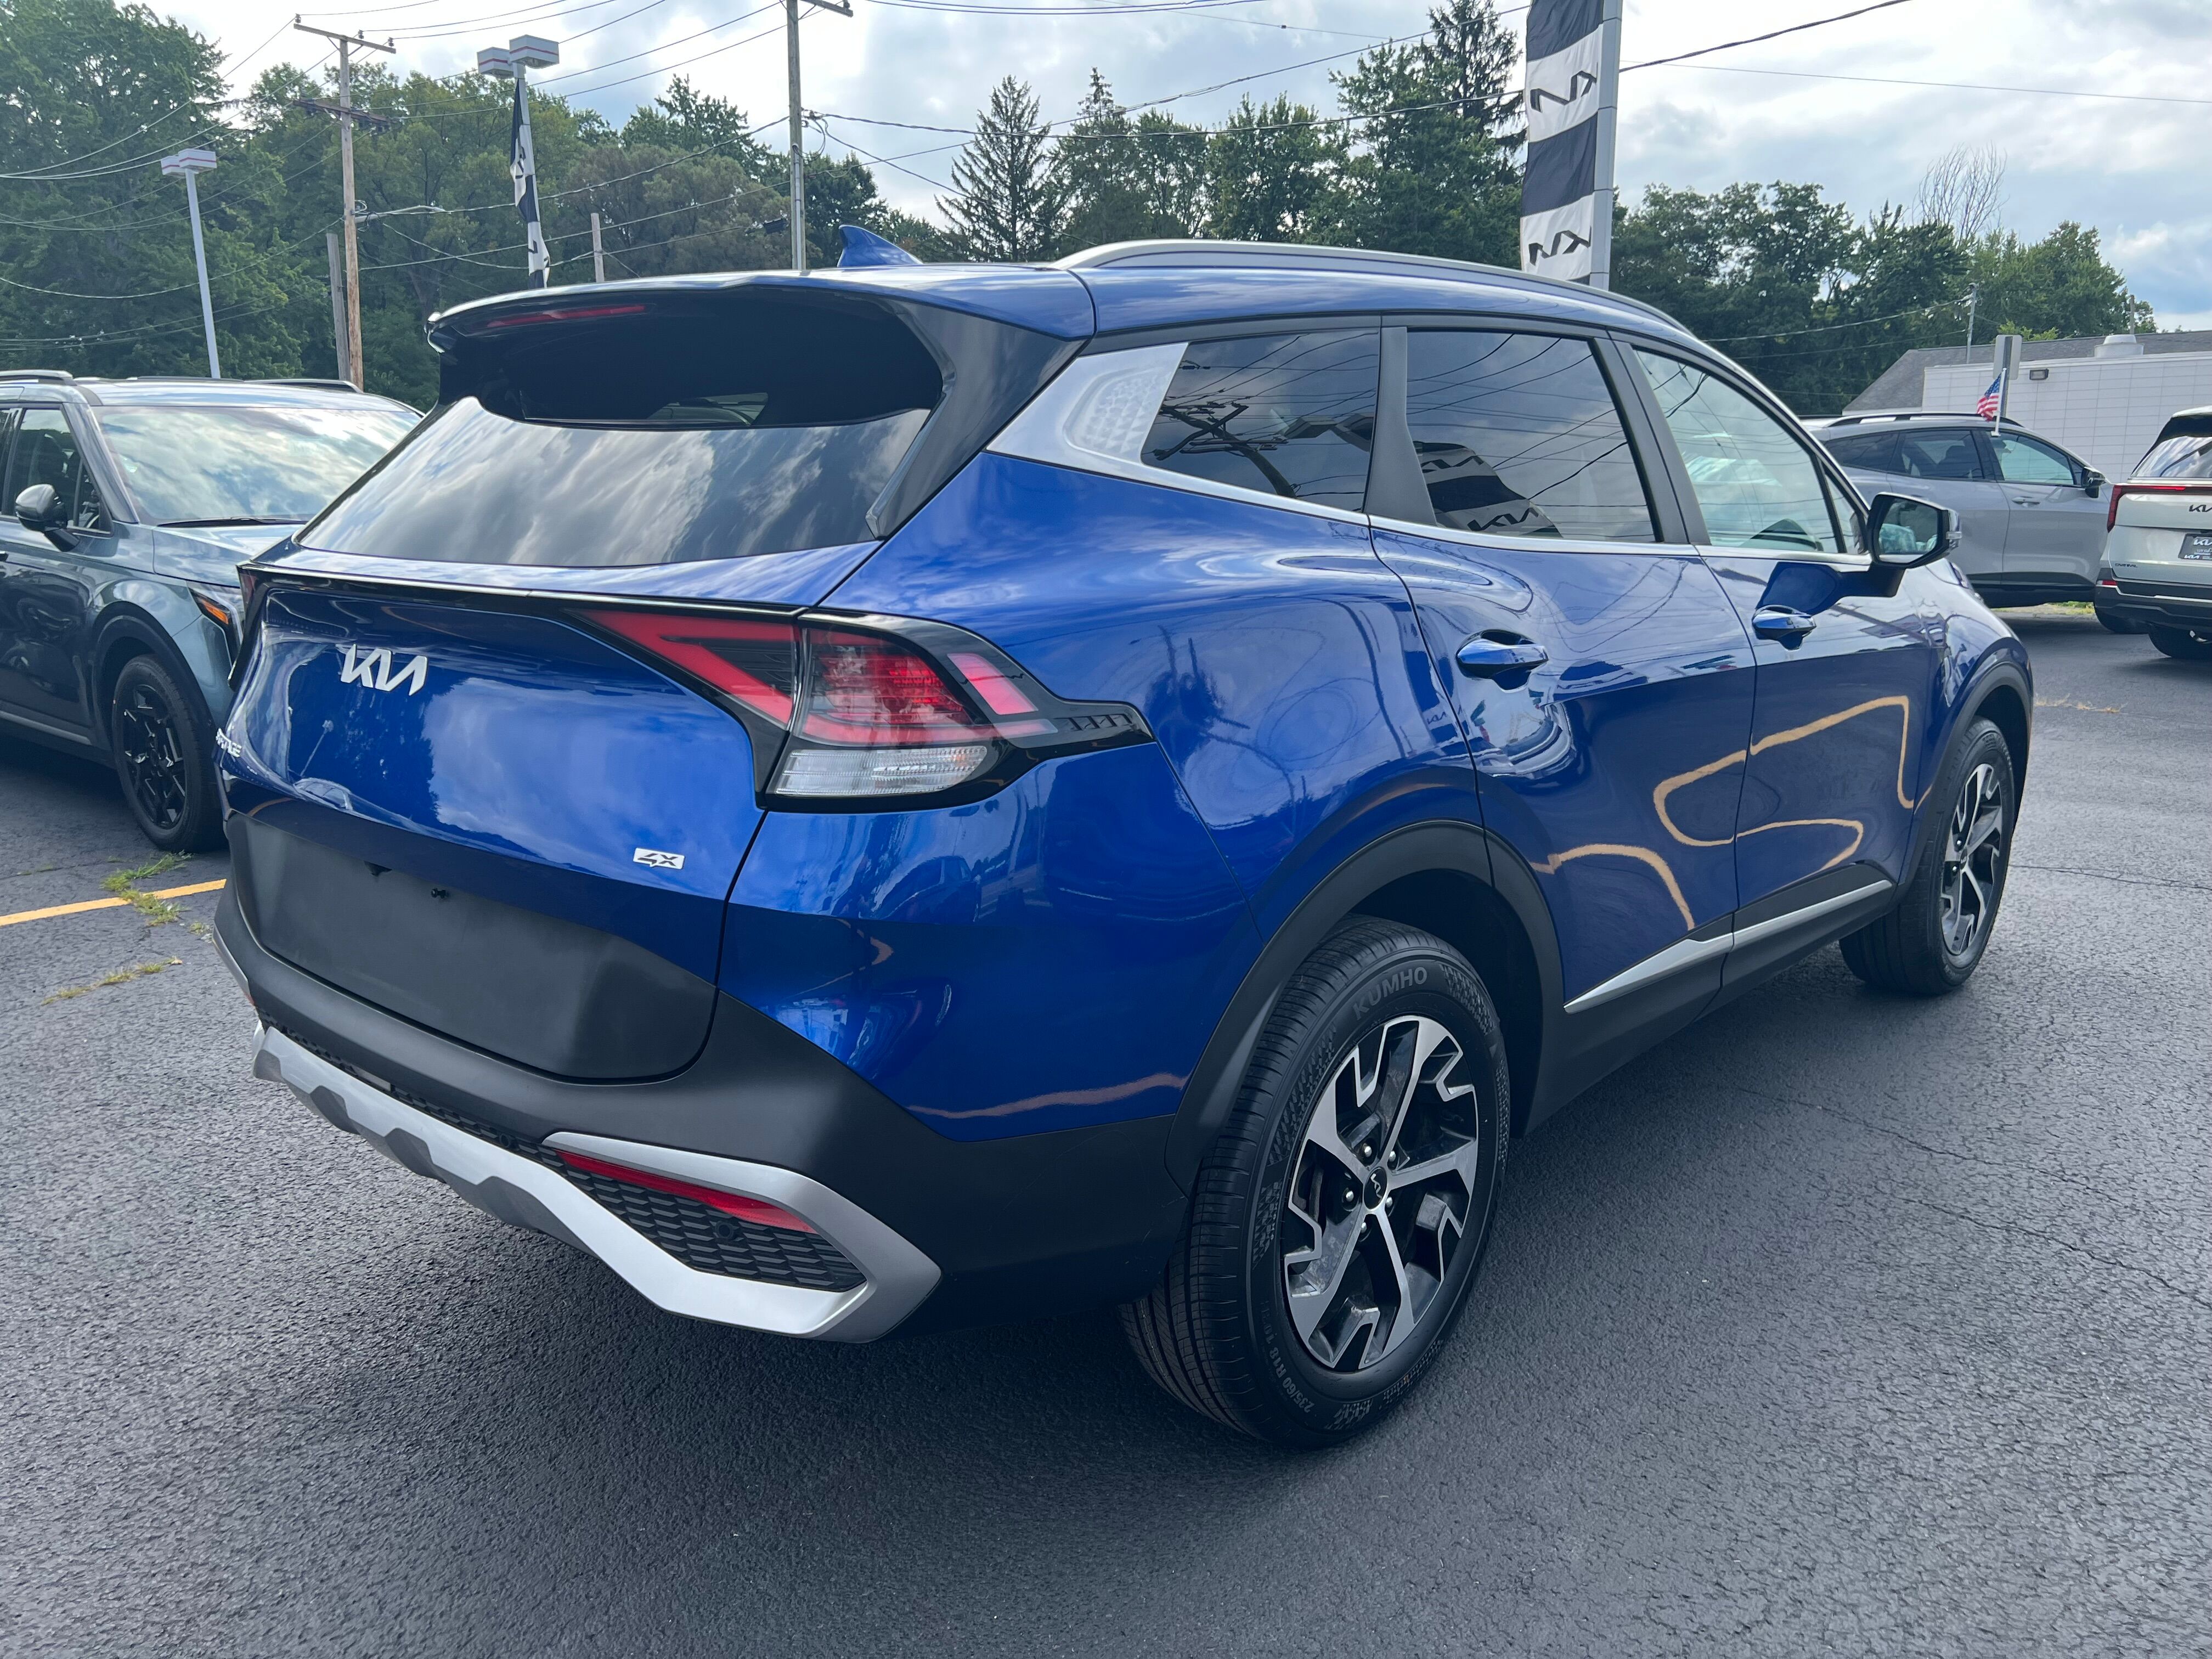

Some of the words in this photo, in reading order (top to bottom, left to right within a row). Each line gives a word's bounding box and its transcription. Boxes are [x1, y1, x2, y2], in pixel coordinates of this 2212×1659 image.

[2189, 504, 2212, 512] KI
[341, 644, 428, 696] KIA
[1352, 967, 1427, 1020] KUMHO
[1269, 1347, 1286, 1379] R18
[1282, 1377, 1315, 1413] 235/60
